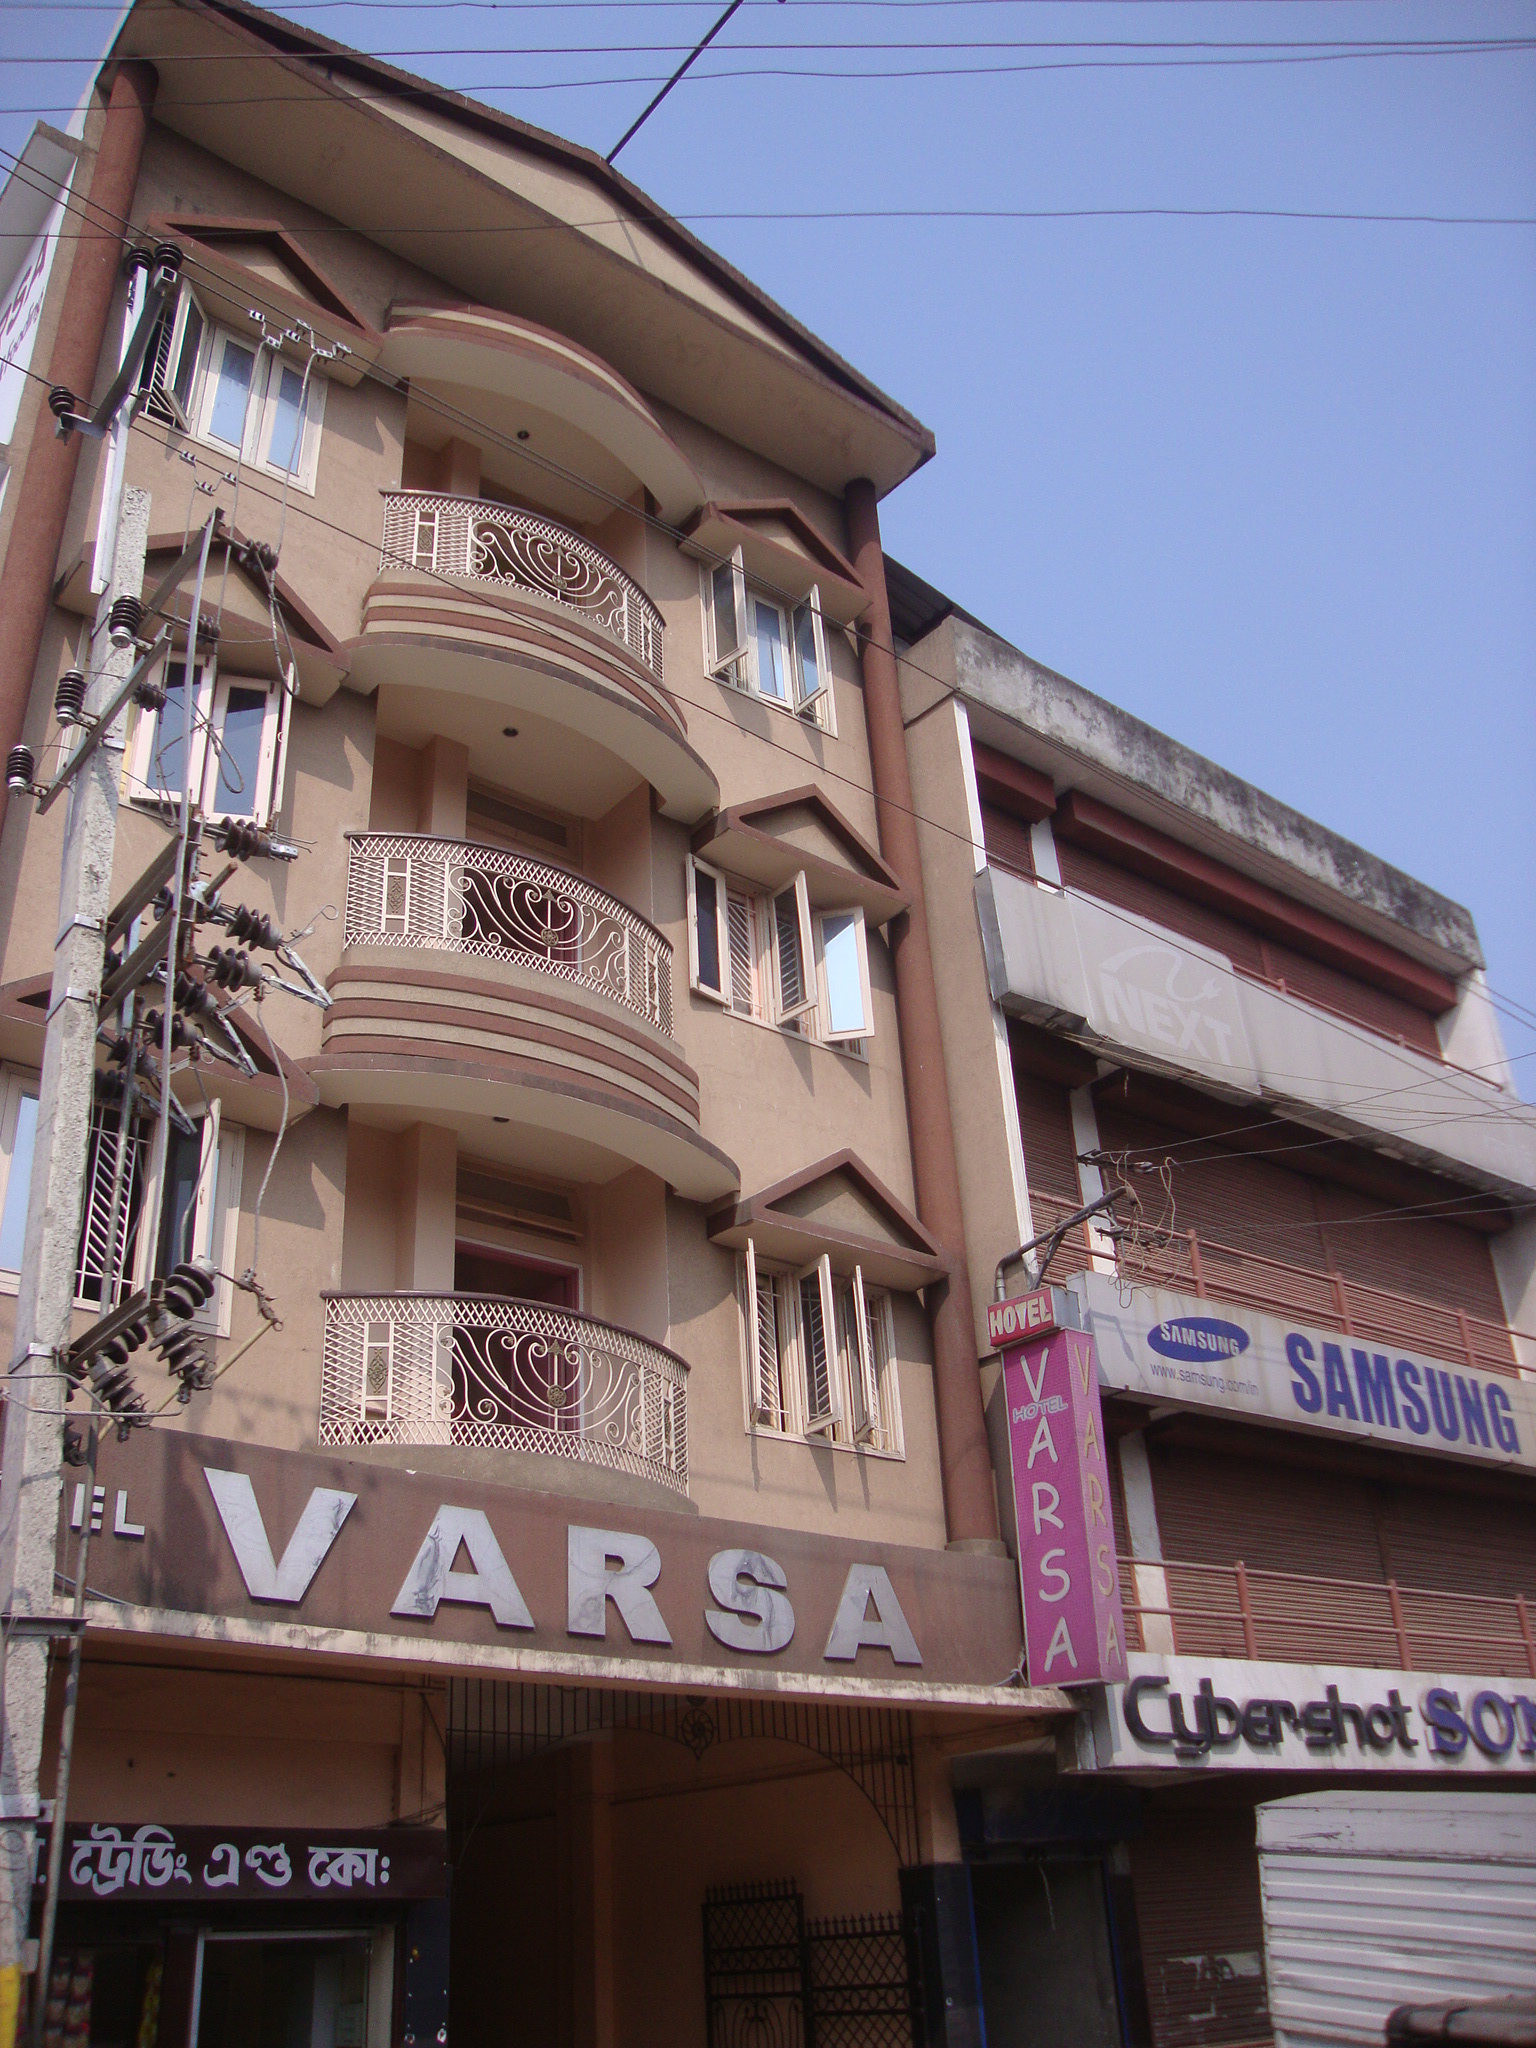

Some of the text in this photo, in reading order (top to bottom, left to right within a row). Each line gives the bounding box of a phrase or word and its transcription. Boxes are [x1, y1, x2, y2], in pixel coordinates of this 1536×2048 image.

[1100, 971, 1233, 1068] NEXT
[988, 1296, 1053, 1338] HOTEL
[1159, 1322, 1241, 1358] SAMSUNG
[1012, 1398, 1069, 1424] HOTEL
[1284, 1332, 1522, 1456] SAMSUNG
[1019, 1347, 1079, 1673] VARSA
[1073, 1343, 1122, 1667] VARSA
[202, 1466, 925, 1666] VARSA
